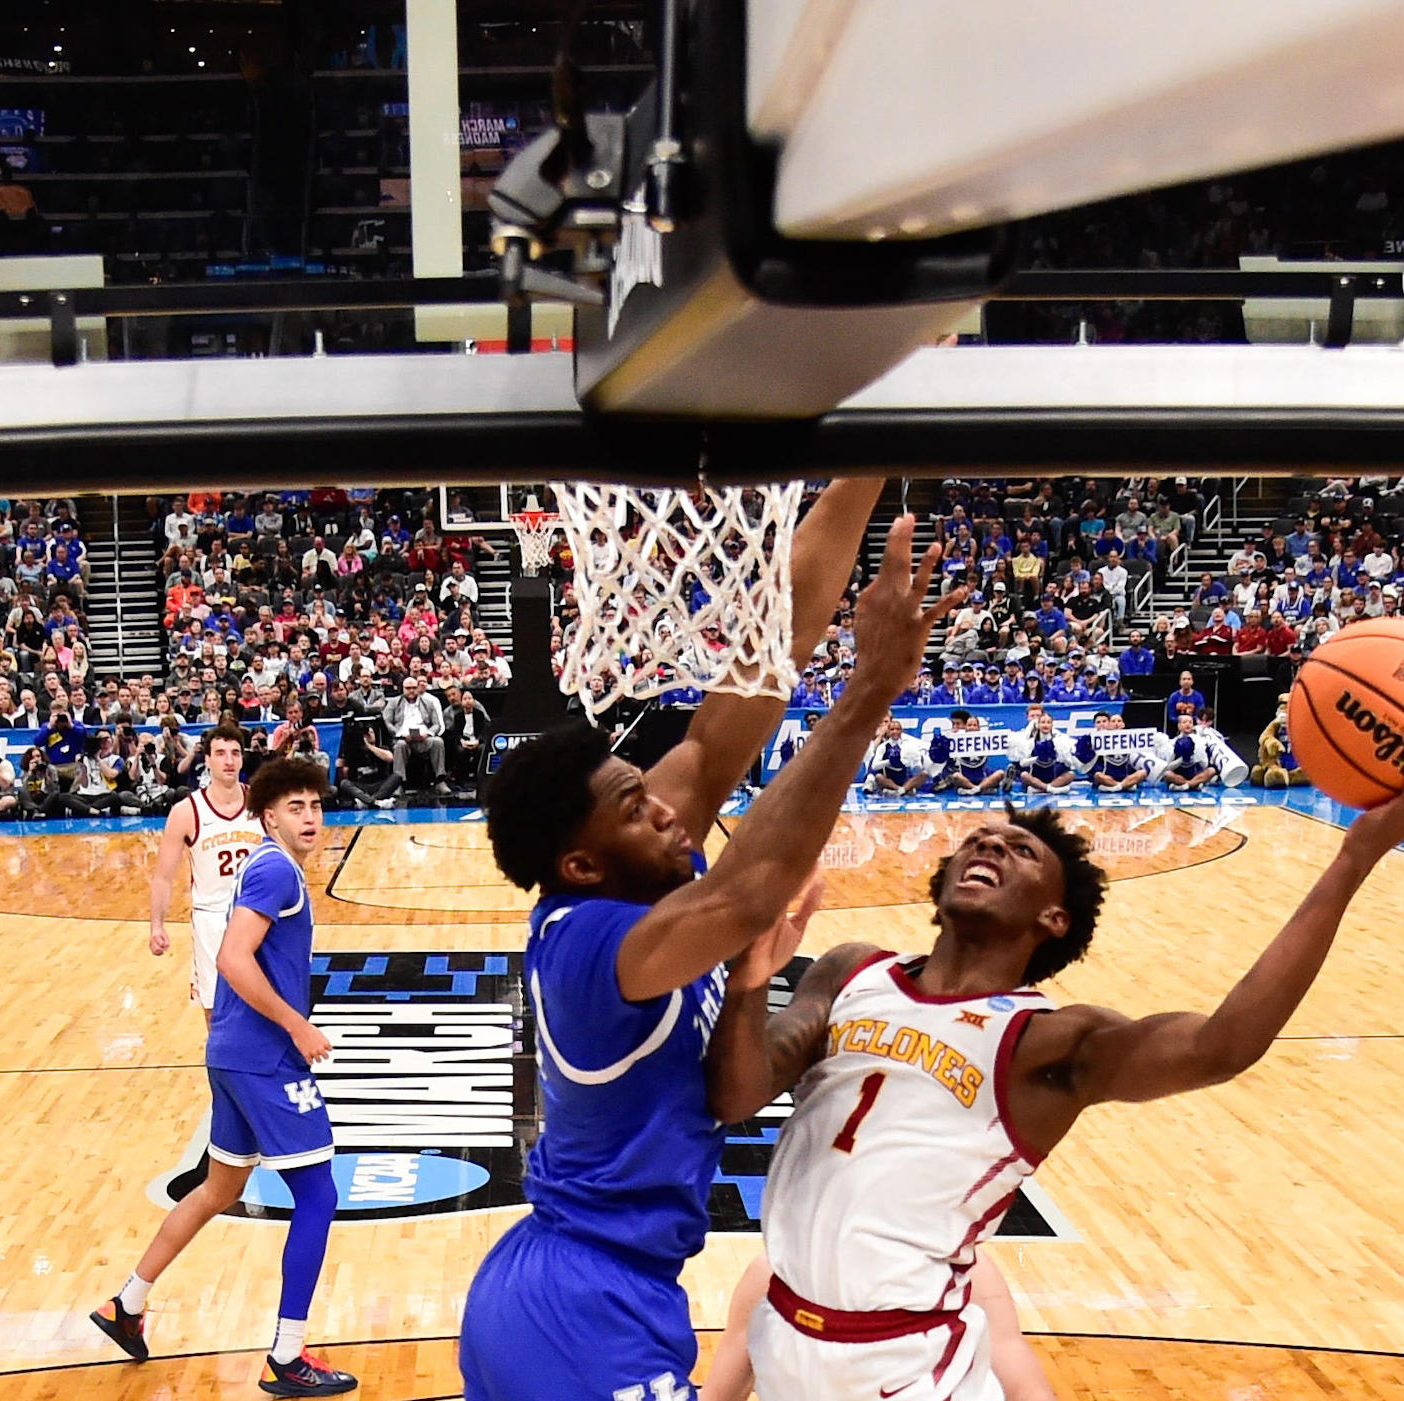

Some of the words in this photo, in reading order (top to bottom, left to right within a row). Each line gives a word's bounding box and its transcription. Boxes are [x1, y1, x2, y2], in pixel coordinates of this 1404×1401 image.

[948, 734, 1009, 753] DEFENSE
[1094, 732, 1155, 751] DEFENSE
[840, 800, 1026, 812] ECOND
[308, 1003, 514, 1148] MARCH
[828, 1018, 985, 1109] YCLONES
[831, 1070, 888, 1154] 1
[348, 1154, 422, 1203] NCAA
